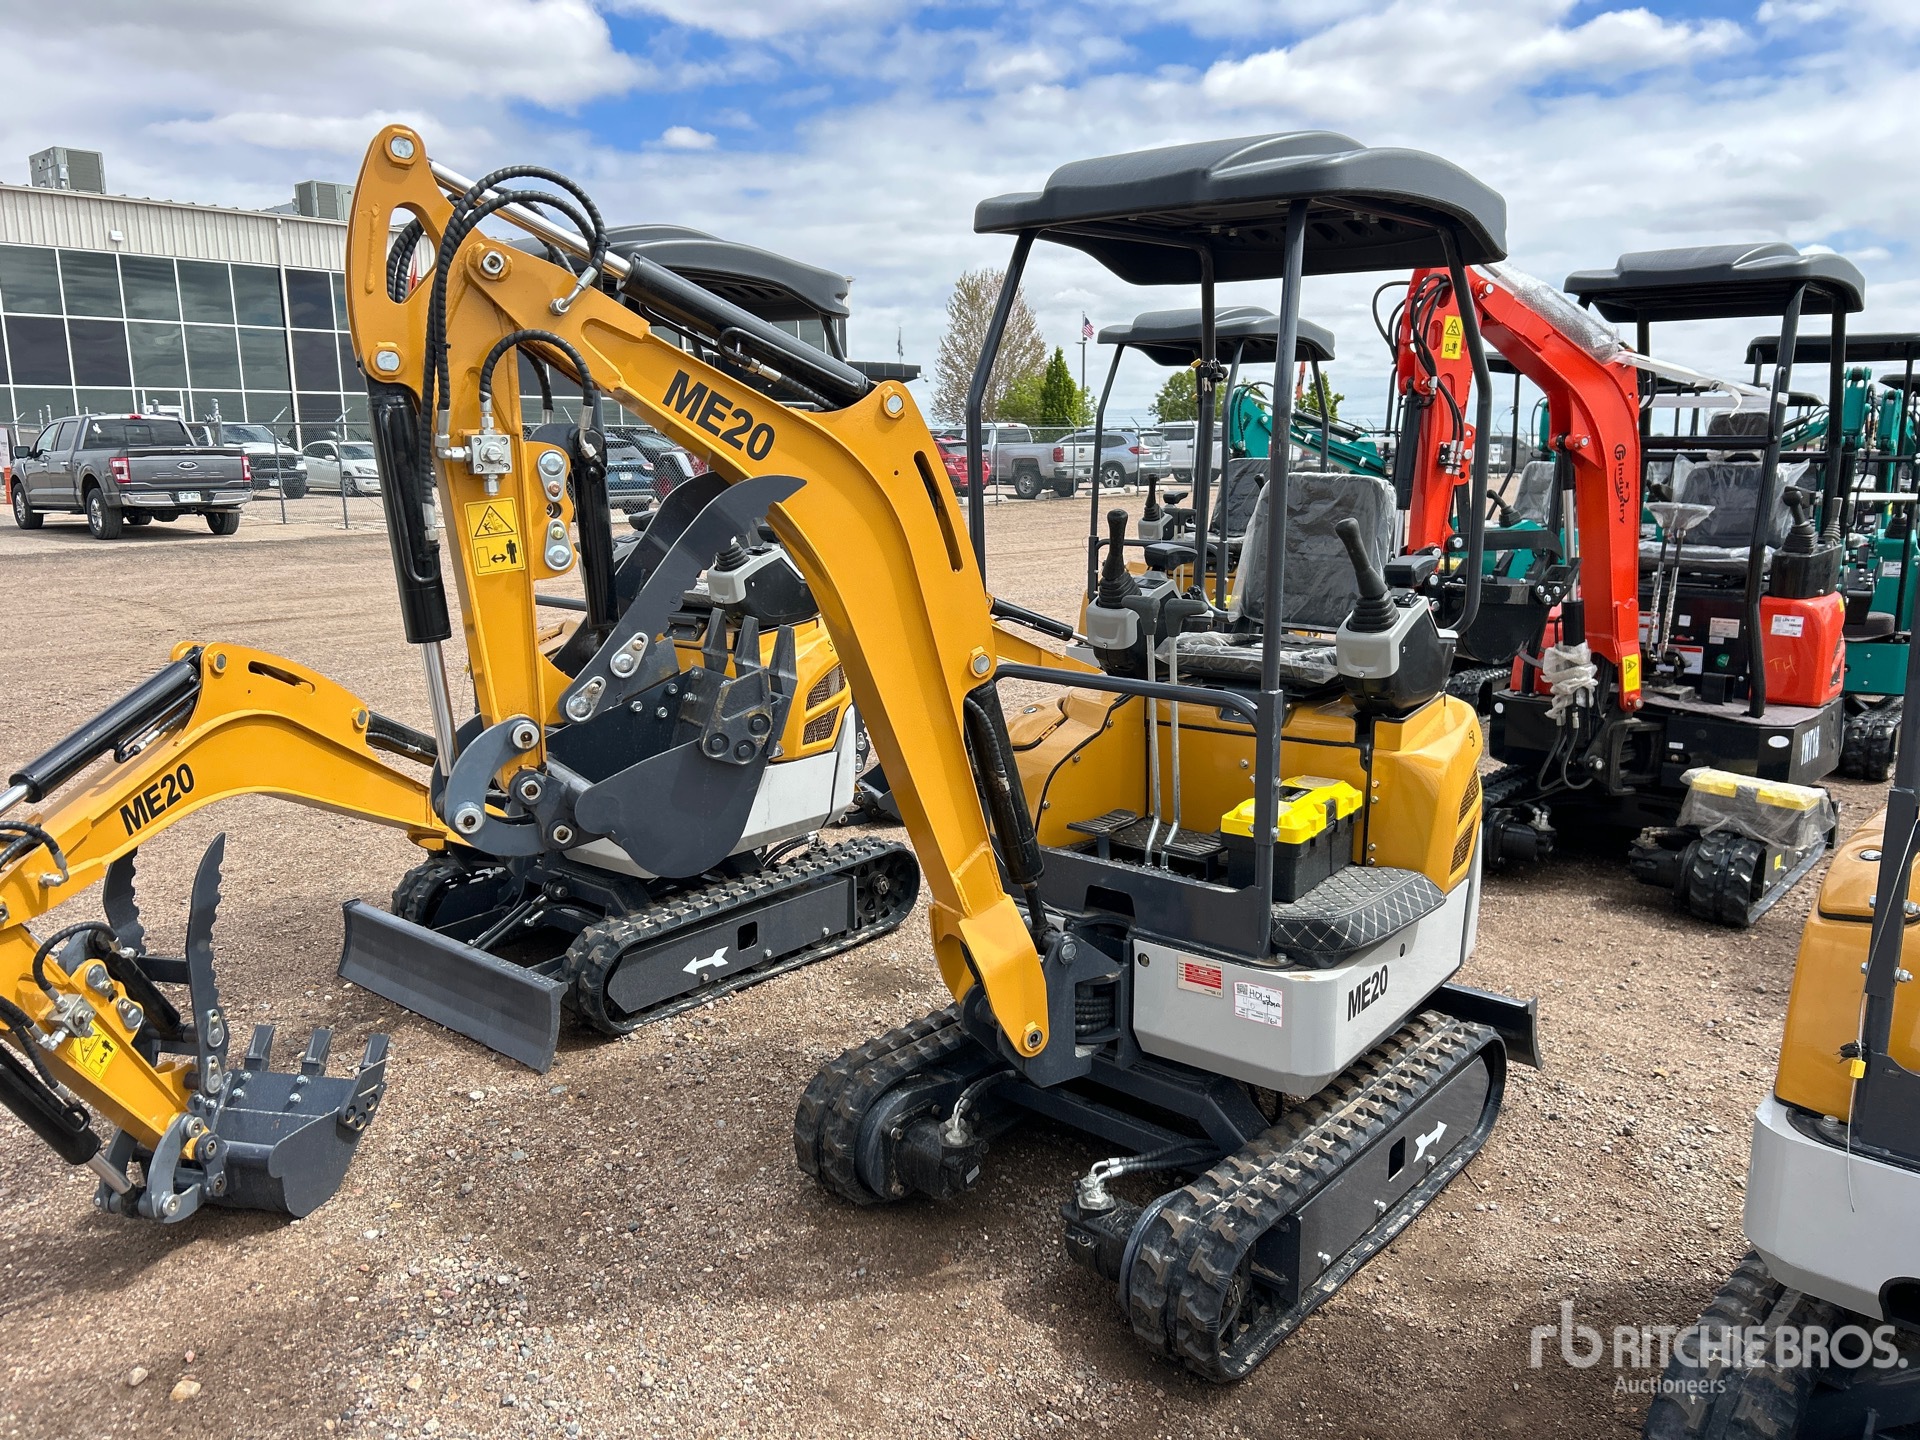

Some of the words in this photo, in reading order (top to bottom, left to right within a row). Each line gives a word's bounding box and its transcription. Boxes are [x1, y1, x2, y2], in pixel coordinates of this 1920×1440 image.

[662, 369, 775, 461] ME20
[119, 763, 194, 837] ME20
[1347, 964, 1388, 1022] ME20
